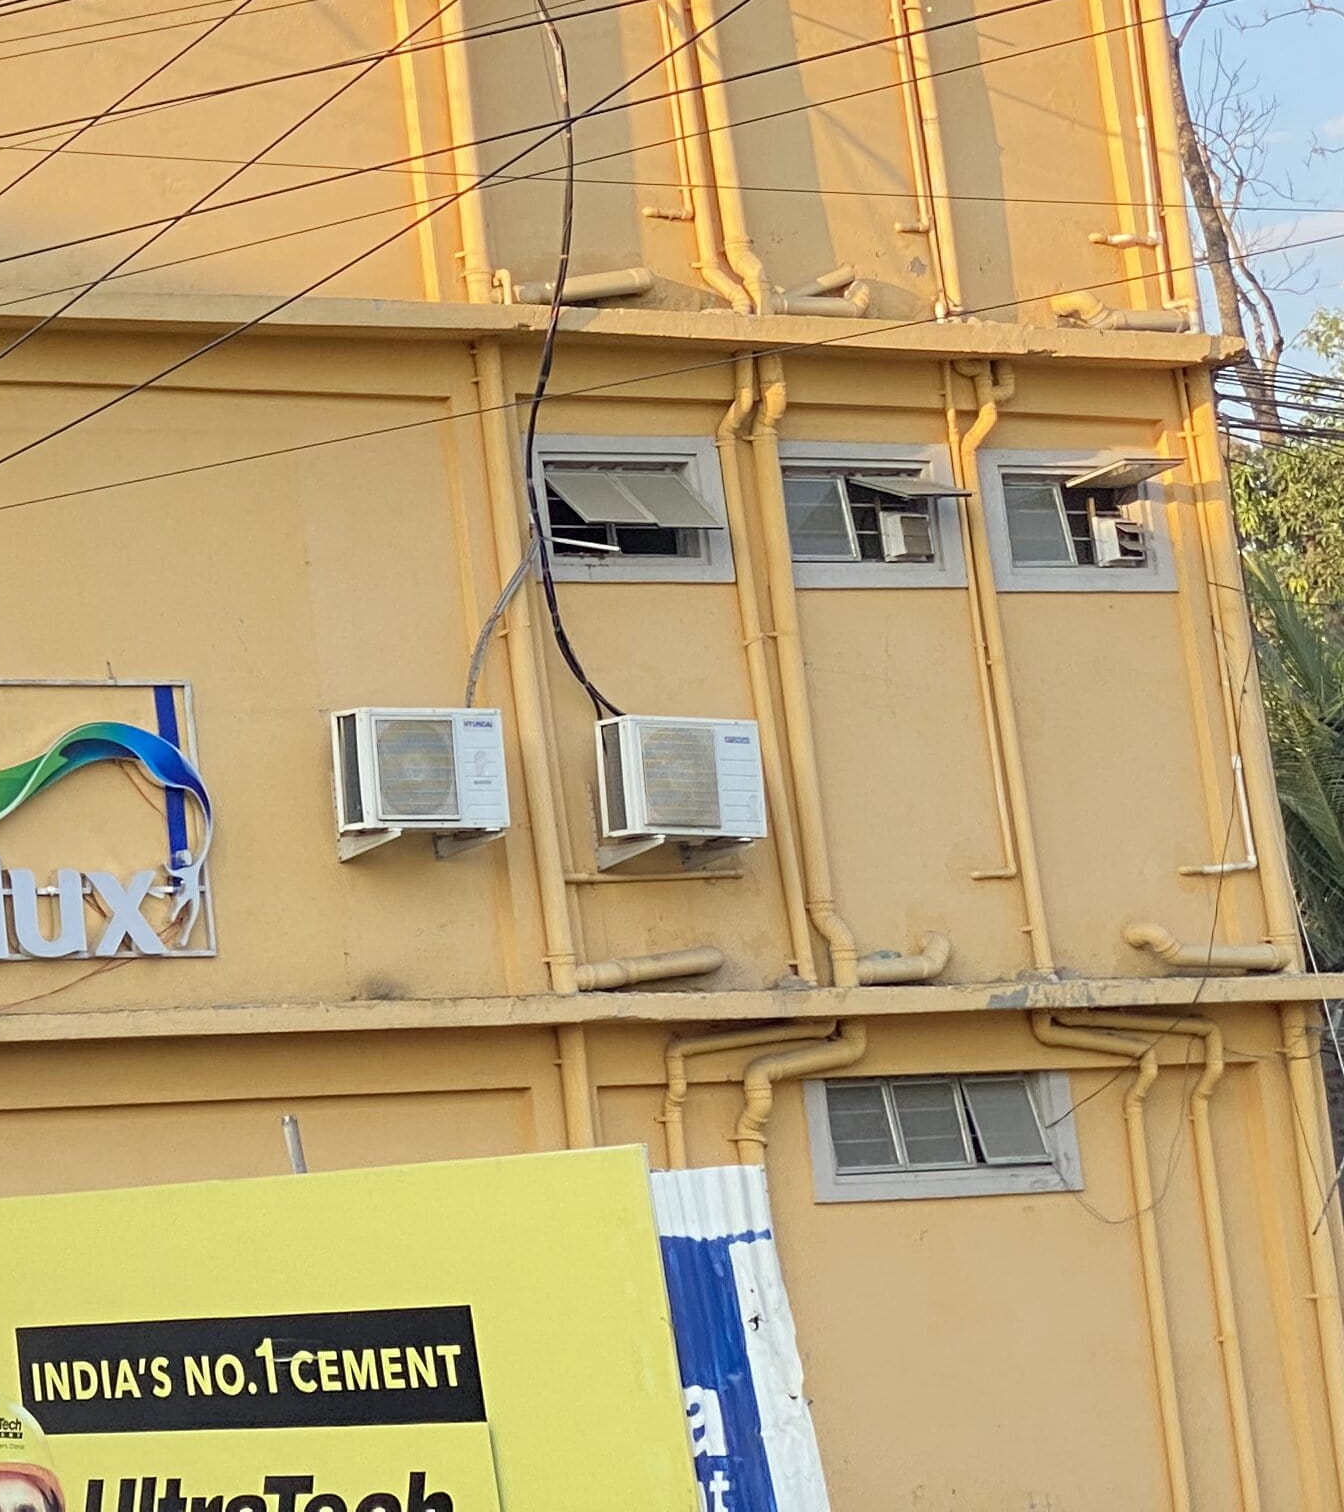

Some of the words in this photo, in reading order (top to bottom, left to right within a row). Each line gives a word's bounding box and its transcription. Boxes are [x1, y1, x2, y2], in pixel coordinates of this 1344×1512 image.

[31, 1355, 172, 1403] INDIA'S
[183, 1337, 279, 1397] NO.1
[288, 1344, 462, 1395] CEMENT
